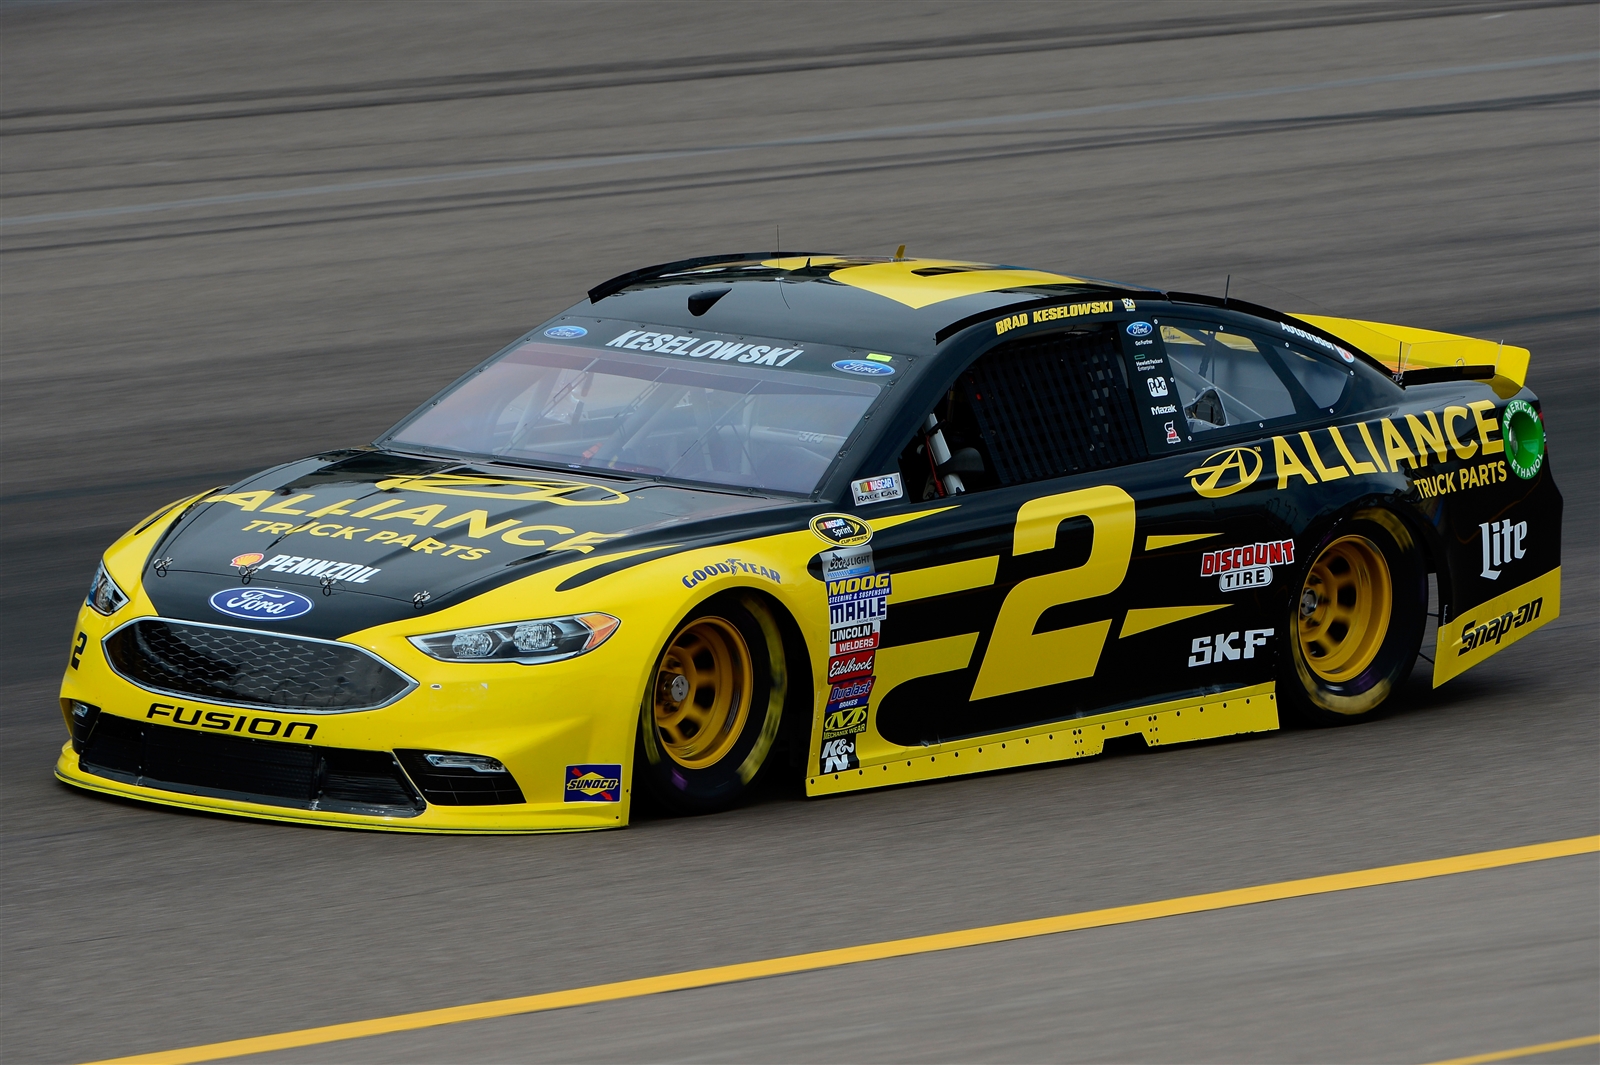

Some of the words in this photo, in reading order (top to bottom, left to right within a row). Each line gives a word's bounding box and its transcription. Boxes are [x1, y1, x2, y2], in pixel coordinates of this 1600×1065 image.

[995, 313, 1028, 335] BRAD
[1033, 301, 1113, 323] KESELOWSKI
[1131, 323, 1149, 335] Ford
[549, 326, 583, 338] Ford
[605, 330, 804, 367] KESELOWSKI
[841, 360, 888, 375] Ford
[1151, 404, 1177, 415] Mazak
[1503, 401, 1539, 429] AMERICAN
[1272, 399, 1505, 490] ALLIANCE
[1511, 453, 1543, 478] ETHANOL
[870, 477, 894, 491] NASCAR
[1414, 470, 1457, 500] TRUCK
[1459, 460, 1507, 490] PARTS
[857, 491, 880, 502] RACE
[881, 489, 898, 498] CAR
[201, 489, 628, 554] ALLIANCE
[832, 526, 852, 537] Sprint
[241, 519, 367, 542] TRUCK
[365, 529, 492, 561] PARTS
[1478, 518, 1527, 580] Lite
[258, 553, 382, 584] PENNZOIL
[851, 554, 870, 566] LIGHT
[1201, 539, 1295, 577] DISCOUNT
[829, 573, 889, 596] MOOG
[1225, 569, 1265, 587] TIRE
[223, 589, 297, 615] Ford
[829, 594, 852, 604] STEERING
[859, 587, 890, 598] SUSPENSION
[969, 484, 1136, 701] 2
[830, 596, 886, 624] MAHLE
[832, 624, 871, 642] LINCOLN
[1457, 597, 1543, 657] Snap-on
[71, 631, 87, 670] 2
[840, 638, 874, 652] WELDERS
[1188, 628, 1274, 667] SKF
[829, 656, 873, 677] Edelbrock
[831, 681, 871, 700] Duralast
[839, 699, 858, 708] BRAKES
[146, 702, 318, 740] FUSION
[823, 730, 848, 740] MECHANIX
[849, 723, 866, 734] WEAR
[568, 779, 617, 790] SUNOCO
